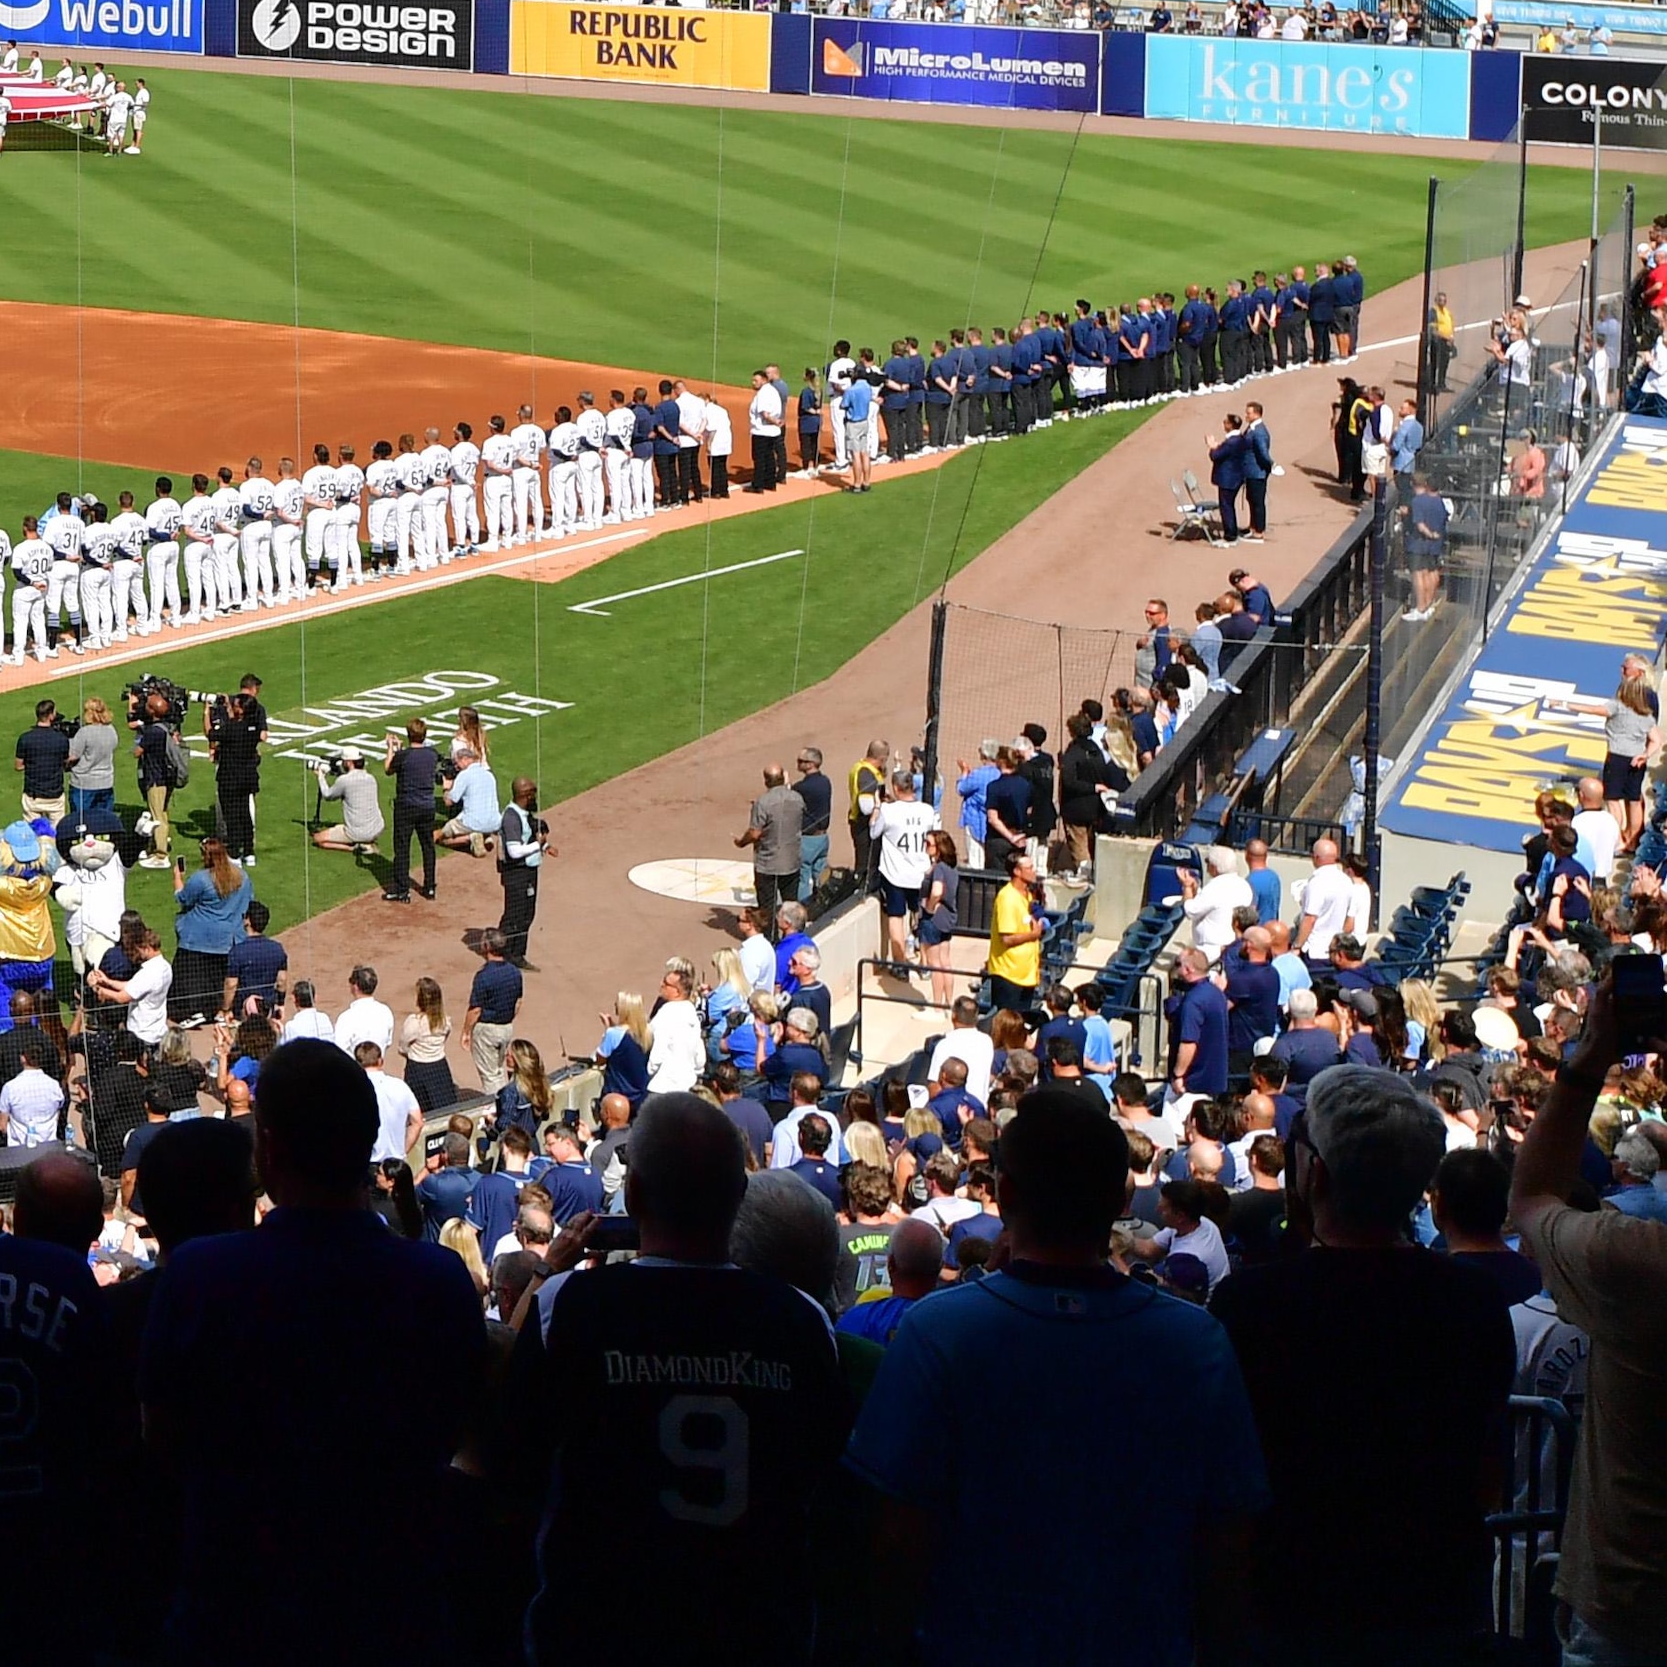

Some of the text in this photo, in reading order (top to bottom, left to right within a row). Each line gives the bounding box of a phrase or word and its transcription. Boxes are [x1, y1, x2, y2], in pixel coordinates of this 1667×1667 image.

[570, 9, 707, 43] REPUBLIC
[596, 40, 678, 70] BANK
[873, 46, 1087, 77] MicroLumen
[873, 65, 1087, 88] HIGH PERFORMANCE MEDICAL DEVICES
[1195, 43, 1415, 111] kane's
[1203, 104, 1407, 131] FURNITURE
[257, 494, 273, 511] 52
[318, 483, 337, 500] 59
[63, 532, 77, 550] 31
[30, 557, 49, 575] 30
[658, 1393, 751, 1527] 9
